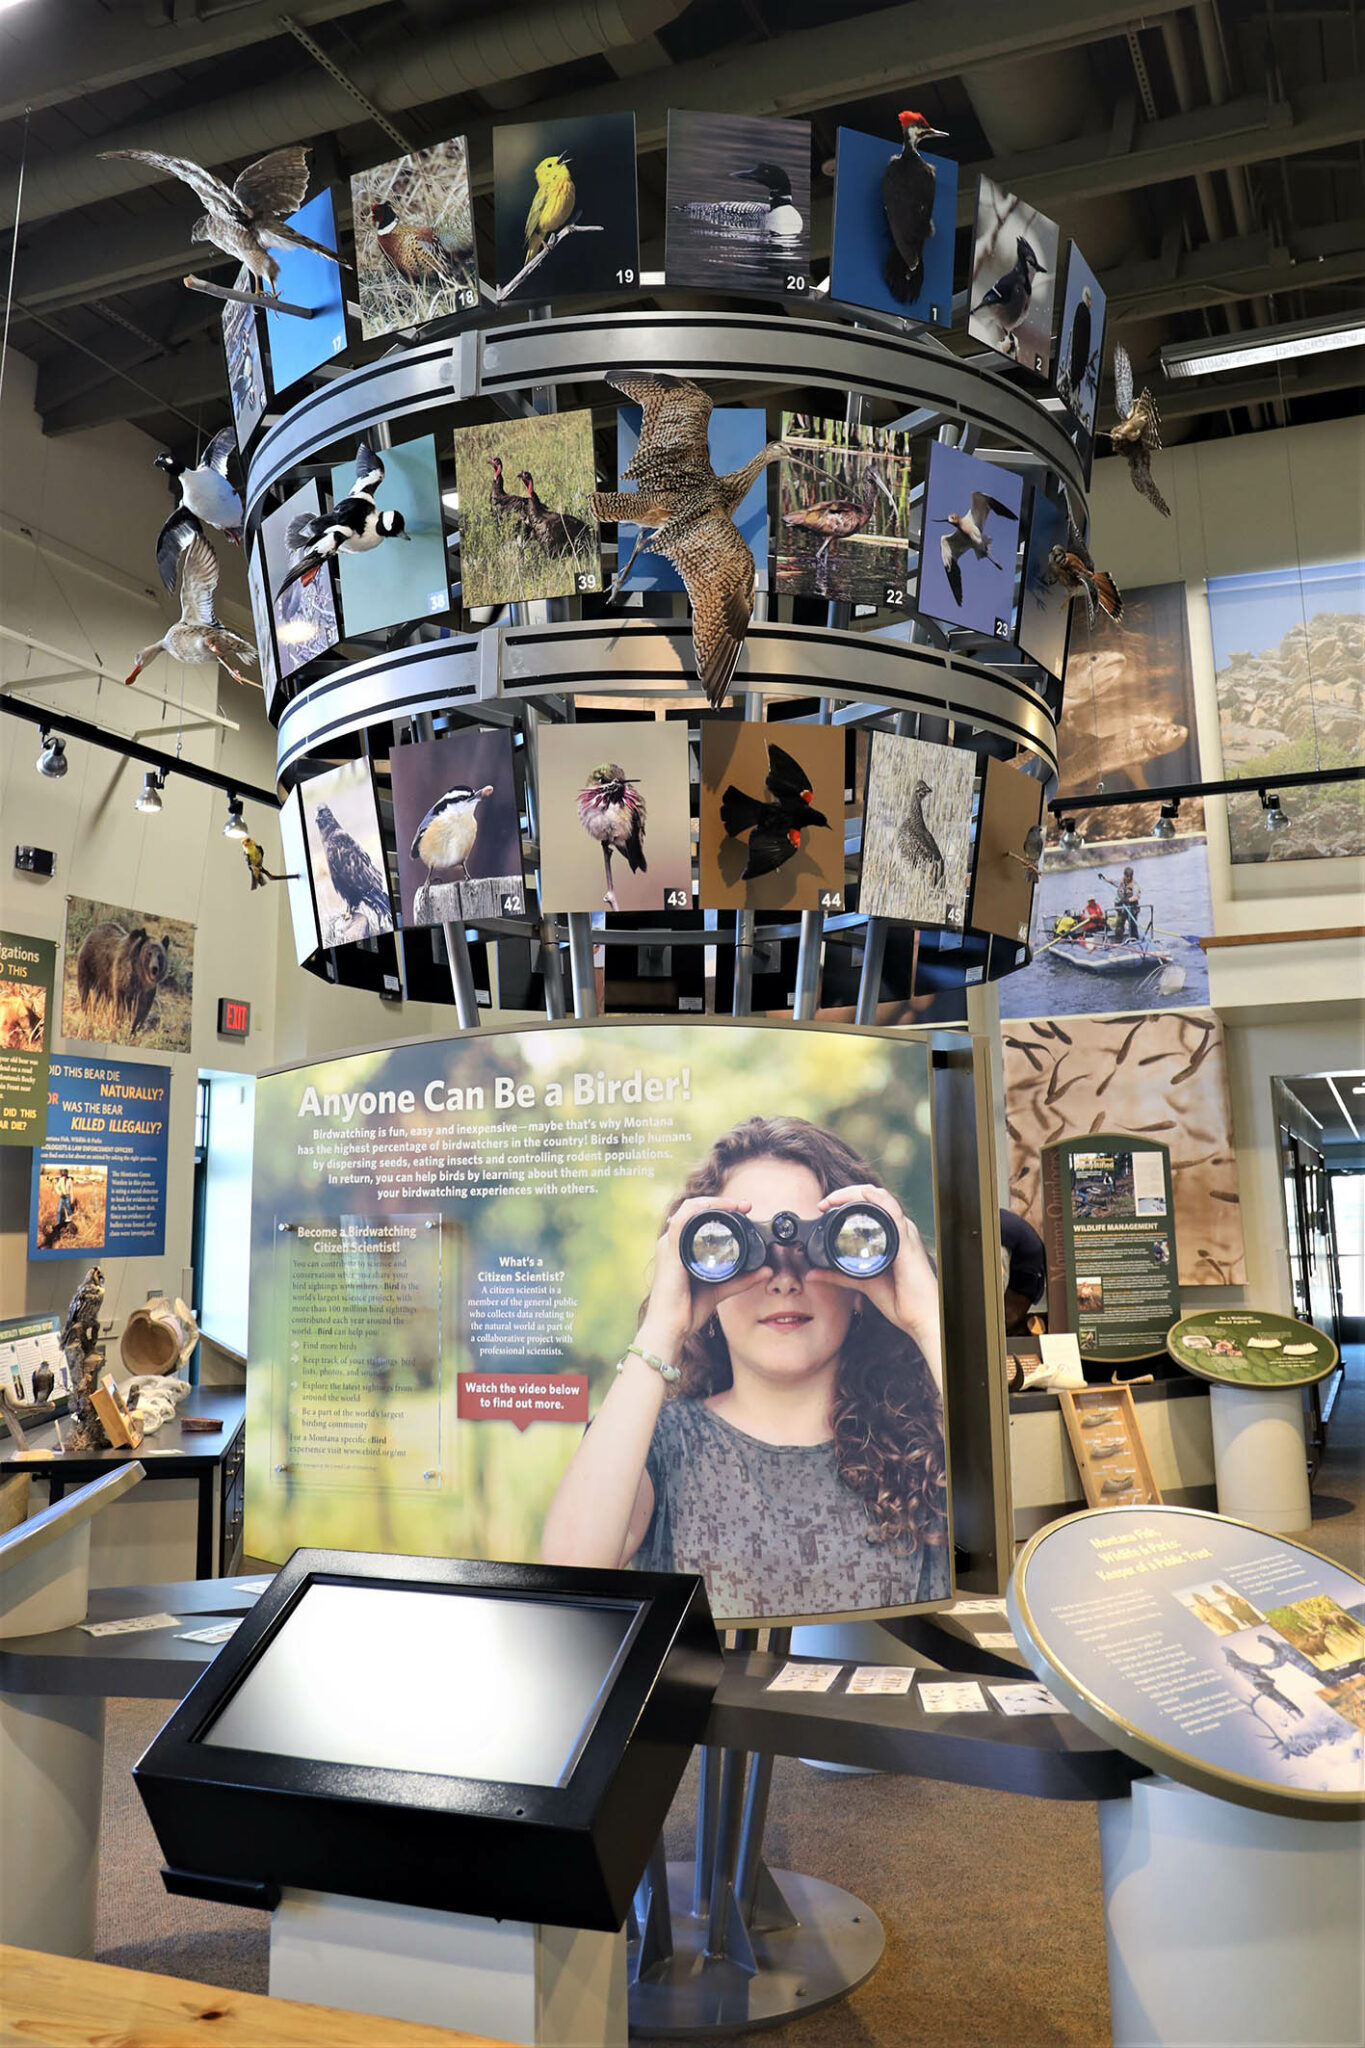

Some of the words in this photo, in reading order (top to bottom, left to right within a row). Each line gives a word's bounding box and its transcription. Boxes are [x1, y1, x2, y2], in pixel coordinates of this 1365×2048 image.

[616, 269, 634, 283] 19
[786, 276, 805, 290] 20
[459, 290, 474, 306] 18
[932, 308, 937, 321] 1
[332, 336, 342, 352] 17
[1036, 358, 1042, 371] 2
[578, 575, 596, 590] 39
[429, 596, 445, 610] 38
[886, 590, 903, 605] 22
[996, 621, 1008, 636] 23
[504, 896, 520, 911] 42
[667, 892, 687, 906] 43
[821, 893, 841, 907] 44
[947, 907, 962, 922] 45
[0, 942, 40, 963] gations
[8, 963, 28, 978] THIS
[226, 1003, 247, 1031] EXIT
[63, 1066, 82, 1078] THIS
[84, 1068, 105, 1080] BEAR
[106, 1070, 120, 1082] DIE
[100, 1084, 164, 1101] NATURALLY?
[298, 1086, 415, 1122] Anyone
[424, 1080, 484, 1112] Can
[495, 1077, 536, 1109] Be
[545, 1082, 562, 1107] a
[574, 1067, 691, 1105] Birder!
[3, 1107, 17, 1117] DID
[20, 1109, 37, 1119] THIS
[62, 1101, 82, 1112] WAS
[84, 1102, 100, 1114] THE
[101, 1104, 123, 1116] BEAR
[70, 1117, 105, 1131] KILLED
[108, 1119, 163, 1134] ILLEGALLY?
[313, 1127, 376, 1140] Birdwatching
[378, 1127, 387, 1137] is
[389, 1127, 408, 1138] fun,
[410, 1128, 433, 1138] easy
[435, 1125, 454, 1136] and
[566, 1119, 596, 1130] that's
[599, 1119, 620, 1131] why
[624, 1116, 673, 1128] Montana
[298, 1145, 314, 1155] has
[316, 1144, 332, 1155] the
[334, 1143, 370, 1155] highest
[372, 1142, 427, 1155] percentage
[430, 1140, 440, 1151] of
[442, 1138, 508, 1151] birdwatchers
[512, 1138, 521, 1148] in
[524, 1137, 540, 1147] the
[543, 1135, 587, 1148] country!
[591, 1134, 619, 1144] Birds
[621, 1133, 644, 1146] help
[647, 1132, 691, 1143] humans
[313, 1160, 324, 1171] by
[327, 1158, 377, 1171] dispersing
[379, 1157, 410, 1169] seeds,
[413, 1156, 444, 1169] eating
[447, 1155, 483, 1166] insects
[486, 1152, 504, 1164] and
[507, 1151, 564, 1165] controlling
[566, 1150, 602, 1162] rodent
[604, 1149, 673, 1162] populations.
[328, 1175, 337, 1184] In
[340, 1174, 373, 1185] return,
[375, 1175, 394, 1185] you
[396, 1174, 413, 1183] can
[416, 1171, 437, 1184] help
[439, 1170, 465, 1182] birds
[467, 1170, 480, 1182] by
[482, 1168, 525, 1181] learning
[528, 1167, 558, 1179] about
[560, 1167, 588, 1178] them
[591, 1166, 610, 1177] and
[613, 1165, 655, 1178] sharing
[377, 1188, 399, 1200] your
[402, 1186, 468, 1199] birdwatching
[470, 1183, 532, 1197] experiences
[535, 1183, 558, 1195] with
[560, 1183, 599, 1194] others.
[298, 1226, 338, 1237] Become
[340, 1229, 346, 1237] a
[349, 1226, 417, 1239] Birdwatching
[1073, 1224, 1106, 1232] WILDLIFE
[1107, 1222, 1158, 1231] MANAGEMENT
[314, 1242, 348, 1253] Citizen
[352, 1241, 400, 1252] Scientist!
[1049, 1221, 1066, 1282] Montana
[499, 1256, 535, 1267] What's
[537, 1259, 543, 1267] a
[477, 1272, 512, 1282] Citizen
[514, 1271, 565, 1282] Scientist?
[481, 1286, 488, 1294] A
[489, 1286, 514, 1294] citizen
[516, 1286, 547, 1294] scientist
[549, 1286, 555, 1294] is
[342, 1305, 367, 1313] million
[370, 1305, 383, 1313] bird
[385, 1306, 417, 1315] sightings
[467, 1298, 498, 1306] member
[500, 1297, 509, 1306] of
[510, 1298, 521, 1306] the
[524, 1298, 552, 1308] general
[554, 1298, 578, 1309] public
[469, 1310, 485, 1318] who
[487, 1310, 515, 1318] collects
[517, 1310, 533, 1318] data
[535, 1310, 564, 1320] relating
[470, 1322, 483, 1330] the
[484, 1322, 511, 1330] natural
[513, 1322, 535, 1330] world
[547, 1324, 563, 1333] part
[564, 1322, 573, 1330] of
[303, 1341, 319, 1350] Find
[340, 1342, 357, 1350] birds
[477, 1334, 525, 1343] collaborative
[526, 1335, 554, 1345] project
[555, 1334, 573, 1343] with
[479, 1346, 525, 1356] professional
[526, 1347, 564, 1356] scientists.
[465, 1382, 497, 1393] Watch
[500, 1382, 516, 1394] the
[519, 1383, 546, 1394] video
[549, 1384, 580, 1395] below
[480, 1398, 490, 1407] to
[492, 1397, 512, 1408] find
[515, 1399, 532, 1408] out
[534, 1400, 564, 1409] more.
[302, 1419, 327, 1430] birding
[328, 1421, 368, 1430] community
